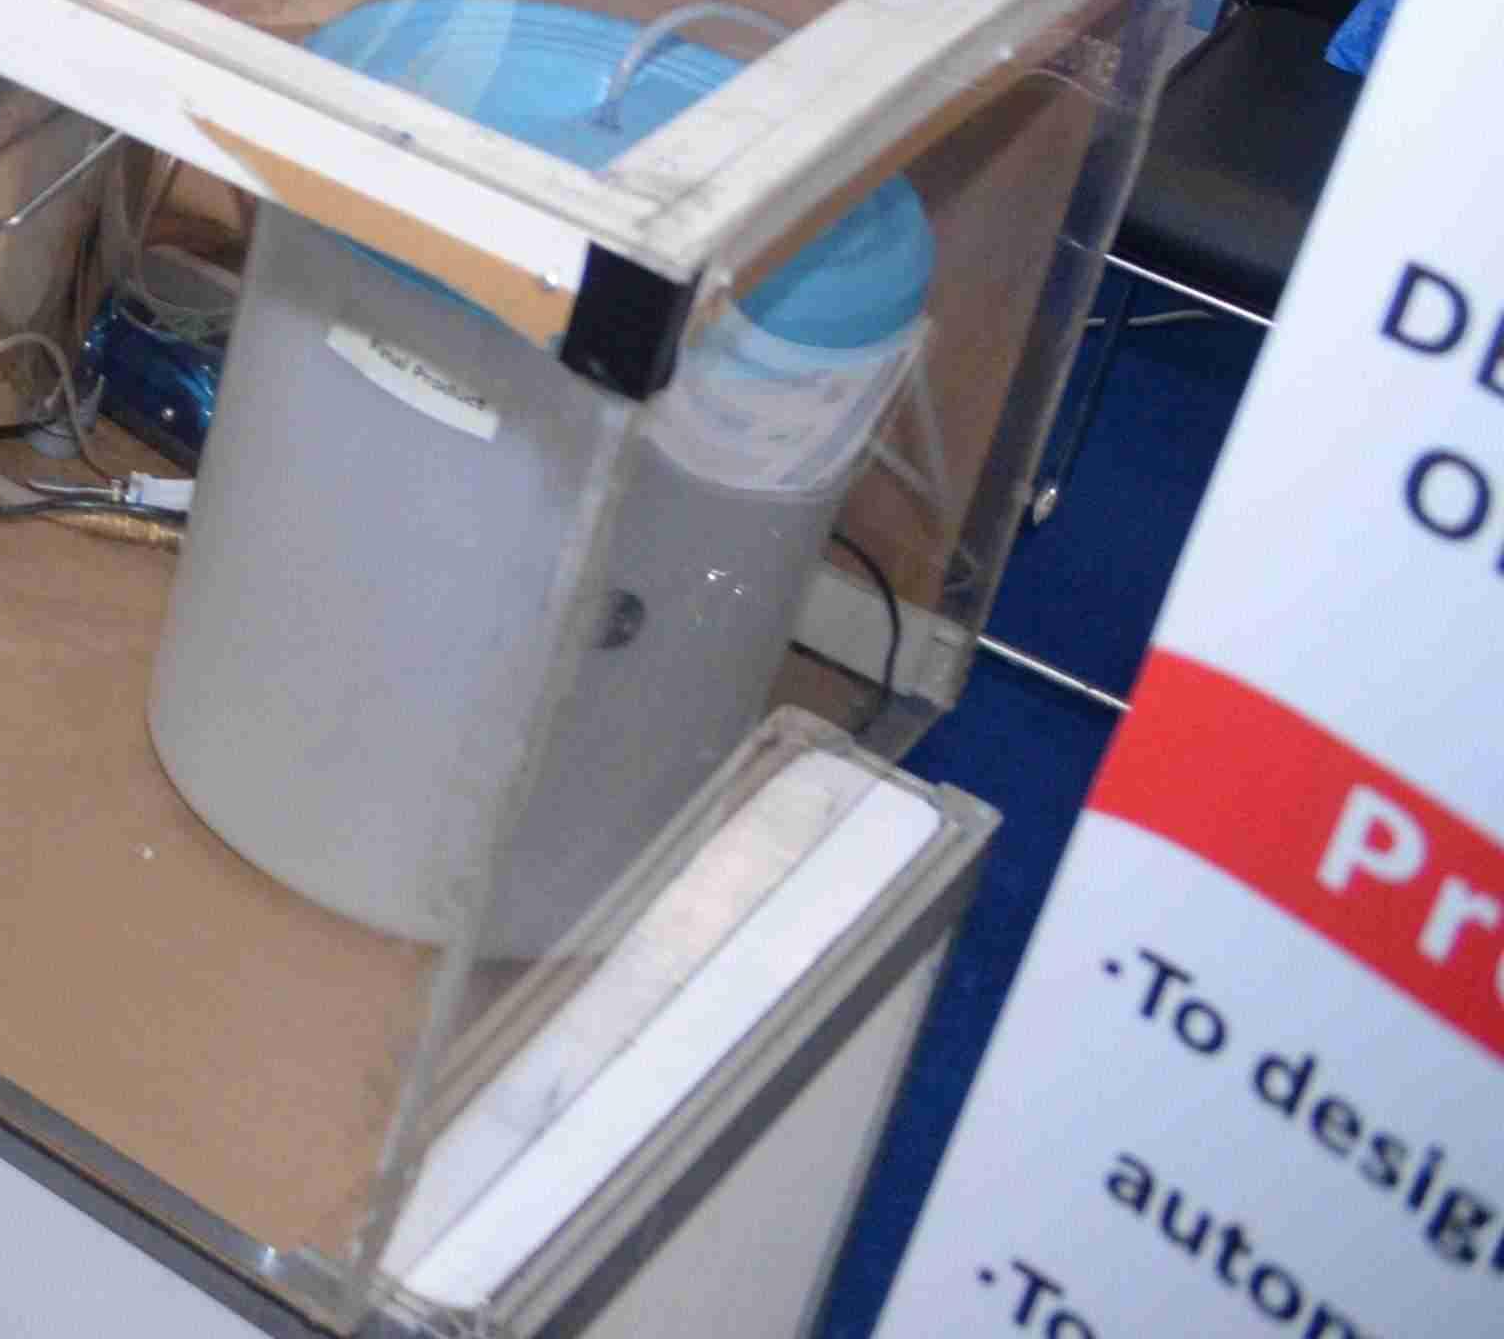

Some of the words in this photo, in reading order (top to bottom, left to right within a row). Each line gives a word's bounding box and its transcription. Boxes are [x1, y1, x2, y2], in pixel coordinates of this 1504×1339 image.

[1314, 783, 1504, 1019] Pr
[1137, 945, 1228, 1058] To
[1251, 1050, 1504, 1276] desig
